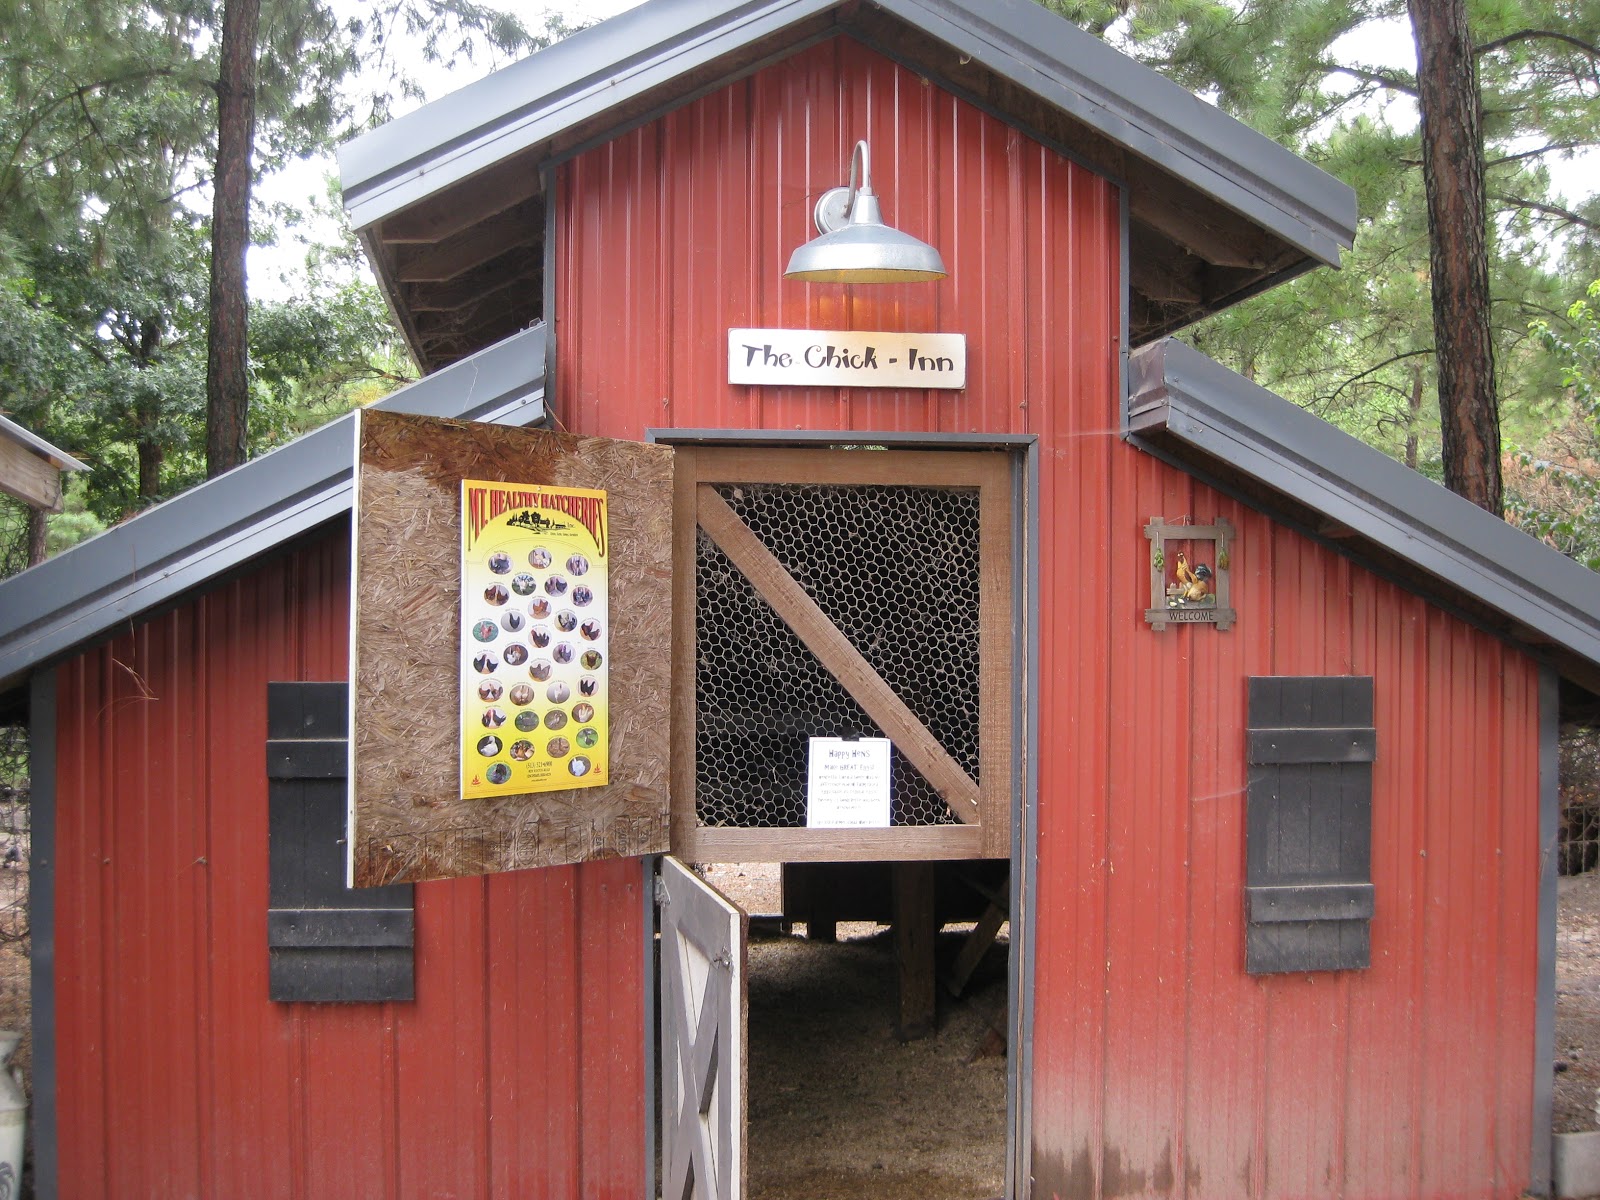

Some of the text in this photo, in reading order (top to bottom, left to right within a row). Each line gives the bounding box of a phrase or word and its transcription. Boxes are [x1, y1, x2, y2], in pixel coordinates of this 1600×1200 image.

[742, 344, 793, 368] The
[804, 345, 878, 370] Chick
[909, 348, 954, 372] Inn
[489, 489, 541, 521] HEALTHY
[541, 493, 606, 557] HATCHERIES
[1169, 611, 1214, 621] WELCOME
[828, 749, 850, 759] Happy
